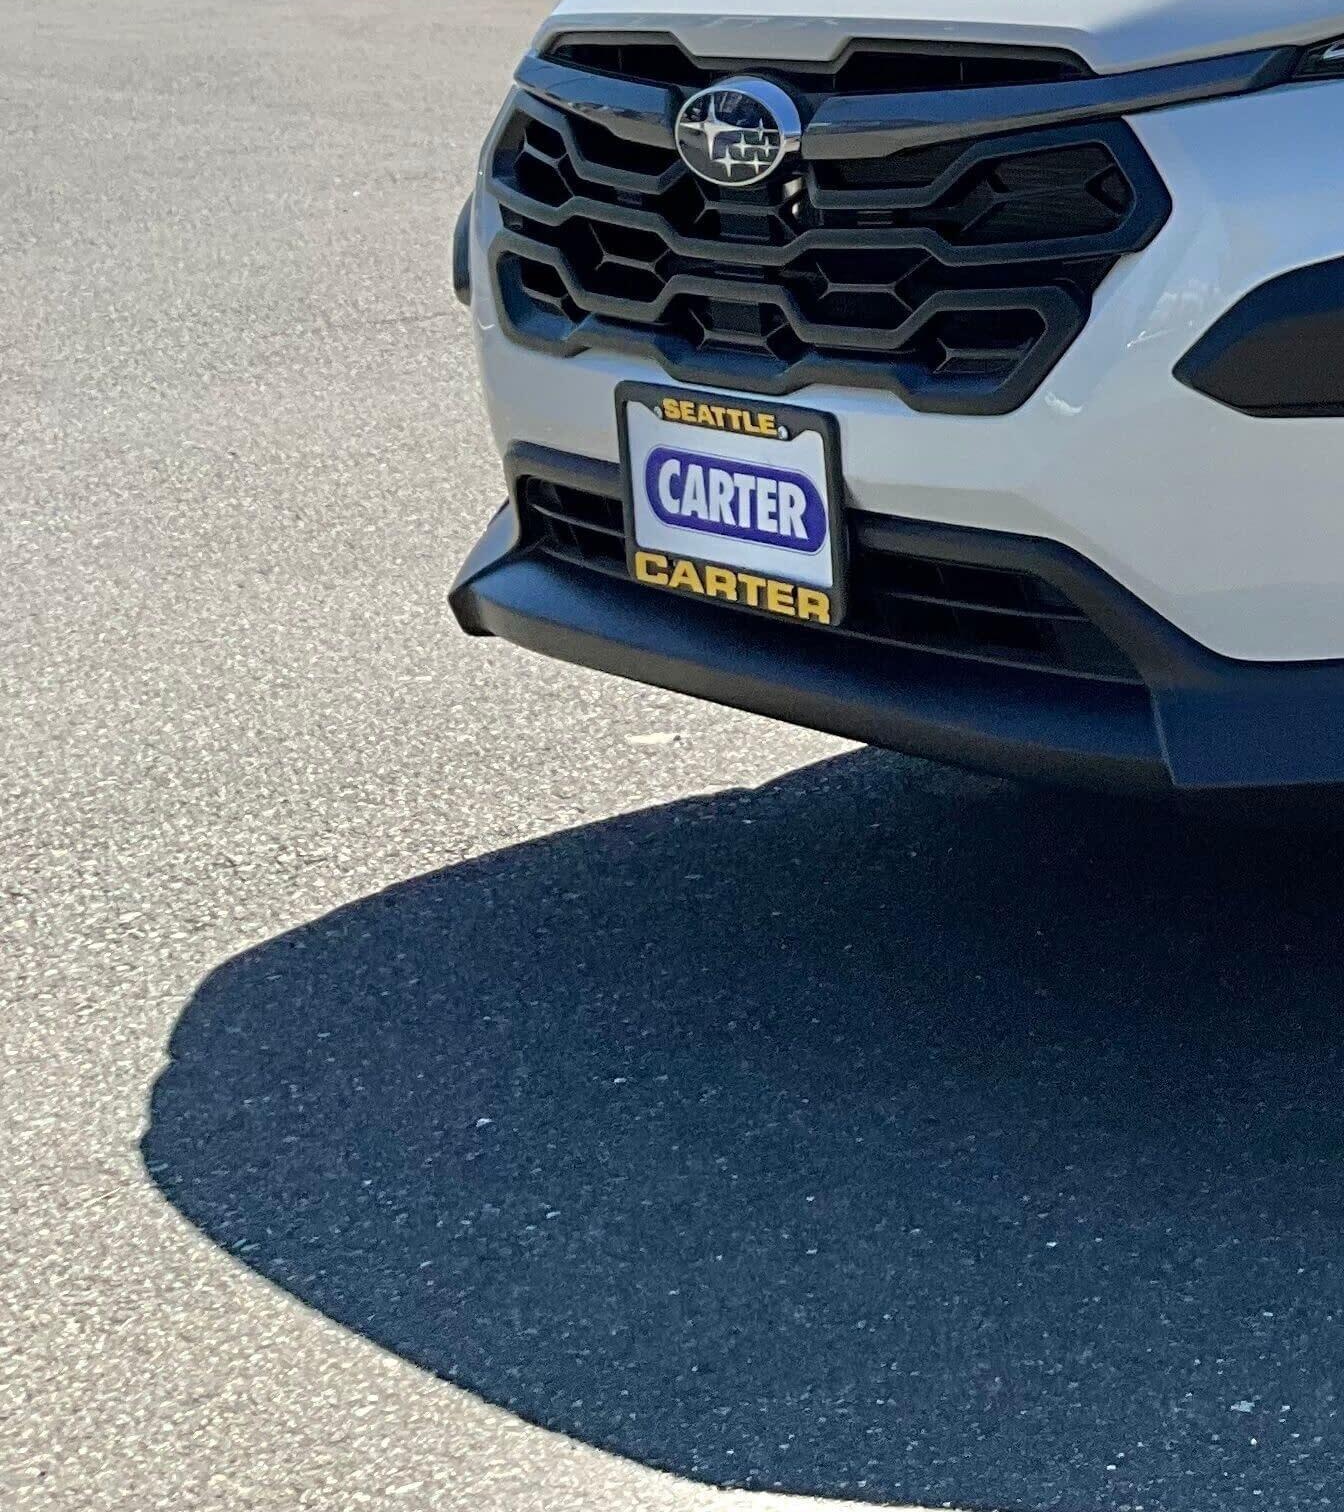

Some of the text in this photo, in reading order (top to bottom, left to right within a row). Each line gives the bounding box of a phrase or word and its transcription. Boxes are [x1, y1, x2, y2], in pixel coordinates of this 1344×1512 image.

[662, 397, 779, 437] SEATTLE
[658, 458, 809, 540] CARTER
[634, 550, 831, 625] CARTER
